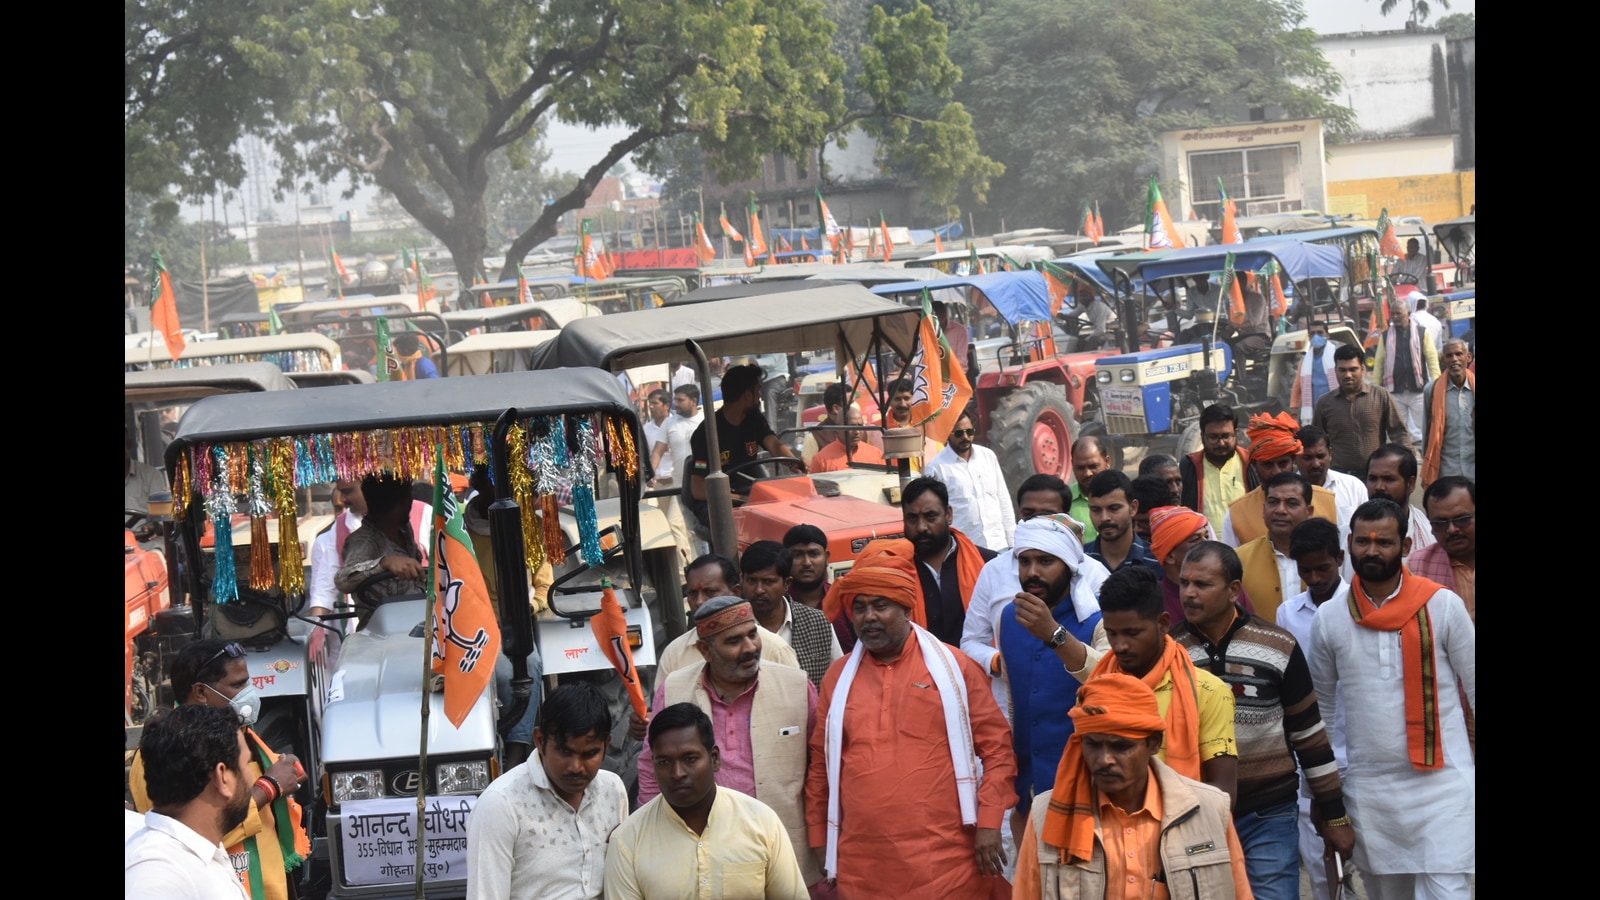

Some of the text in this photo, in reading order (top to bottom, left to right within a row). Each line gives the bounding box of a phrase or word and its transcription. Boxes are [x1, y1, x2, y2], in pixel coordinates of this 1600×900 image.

[251, 675, 276, 690] शुभ
[348, 812, 411, 839] आनन्द
[380, 862, 414, 878] गोहना
